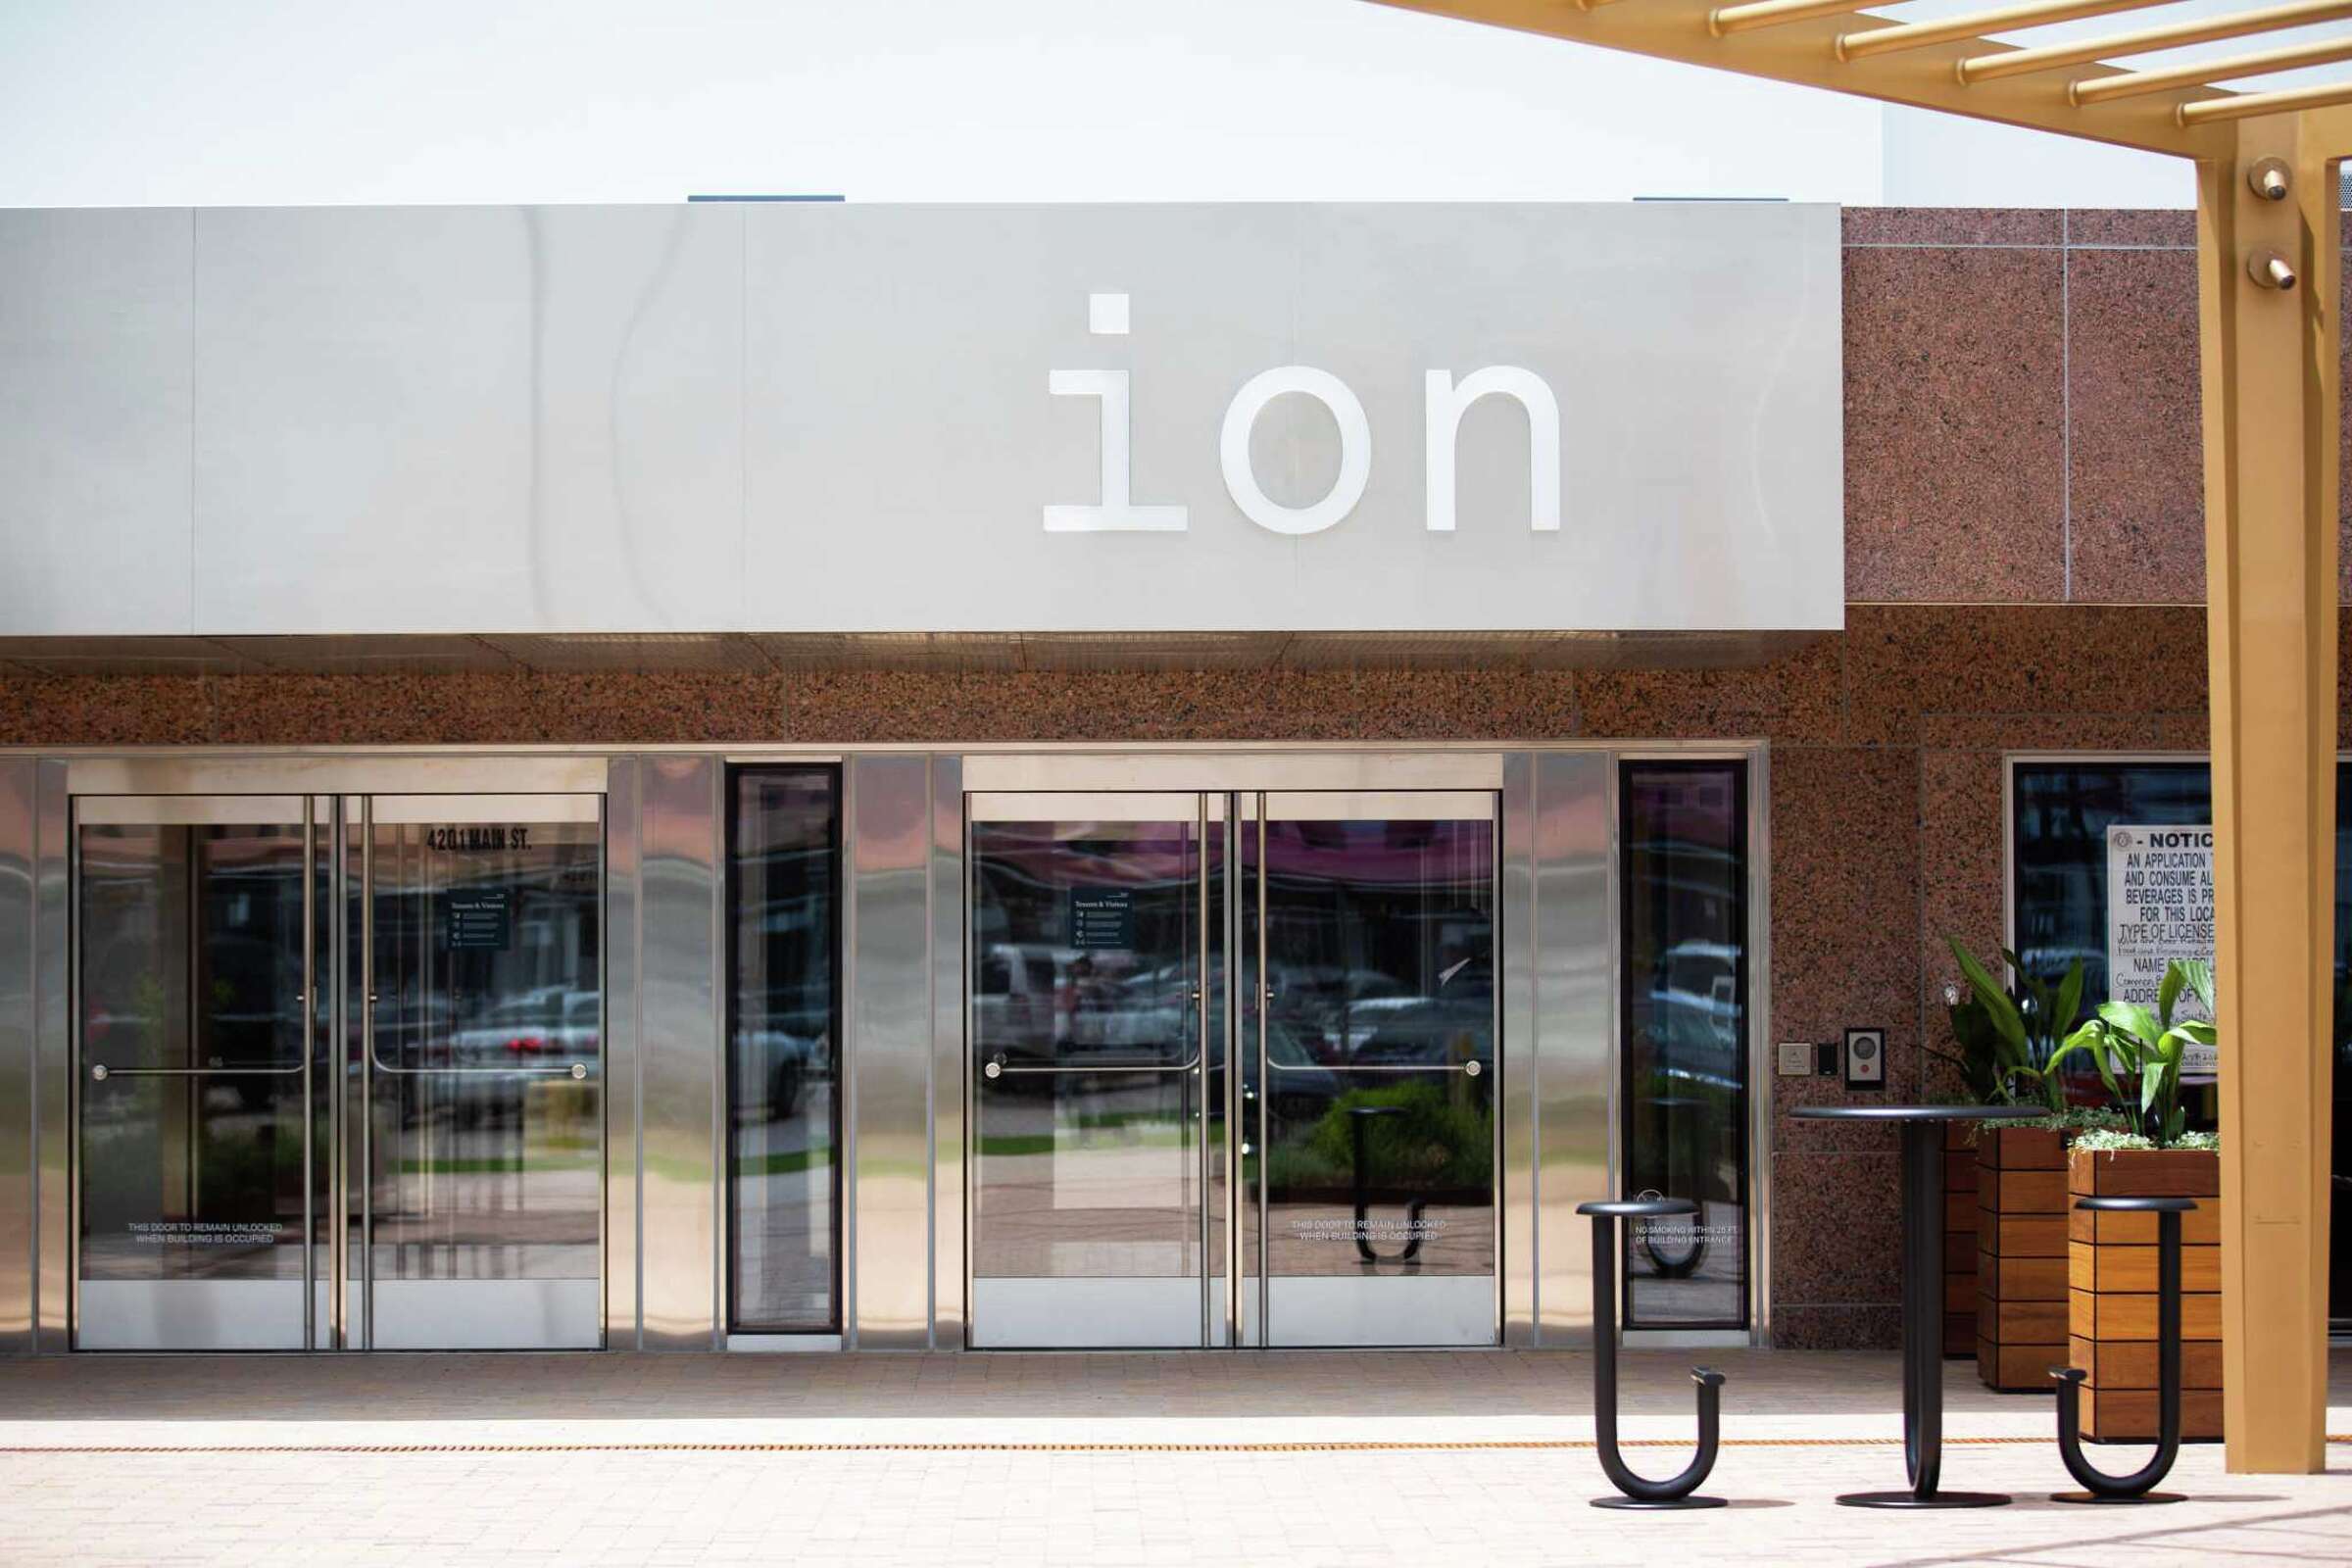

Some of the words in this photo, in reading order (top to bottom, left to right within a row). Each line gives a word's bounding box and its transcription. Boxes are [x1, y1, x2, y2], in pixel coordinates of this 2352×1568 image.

[1043, 293, 1560, 534] ion
[426, 828, 466, 851] 4201
[468, 828, 506, 851] MAIN
[511, 828, 532, 851] ST.
[2127, 853, 2140, 868] AN
[2144, 853, 2206, 868] APPLICATION
[2125, 870, 2144, 887] AND
[2149, 870, 2196, 887] CONSUME
[2126, 889, 2183, 904] BEVERAGES
[2188, 889, 2197, 904] IS
[2139, 906, 2160, 921] FOR
[2164, 906, 2185, 921] THIS
[2120, 924, 2148, 939] TYPE
[2150, 924, 2166, 939] OF
[2132, 957, 2165, 972] NAME
[128, 1223, 150, 1232] THIS
[150, 1223, 178, 1232] DOOR
[179, 1223, 192, 1232] TO
[193, 1223, 230, 1232] REMAIN
[231, 1223, 283, 1232] UNLOCKED
[1293, 1220, 1312, 1230] THIS
[1314, 1220, 1342, 1230] DOOR
[1344, 1220, 1355, 1230] TO
[1357, 1220, 1395, 1230] REMAIN
[1396, 1220, 1446, 1230] UNLOCKED
[136, 1234, 166, 1243] WHEN
[167, 1234, 213, 1243] BUILDING
[215, 1234, 223, 1243] IS
[224, 1234, 274, 1243] OCCUPIED
[1299, 1231, 1330, 1241] WHEN
[1332, 1231, 1376, 1241] BUILDING
[1377, 1231, 1388, 1241] IS
[1389, 1231, 1438, 1241] OCCUPIED
[1635, 1236, 1647, 1245] OF
[1647, 1236, 1688, 1245] BUILDING
[1688, 1236, 1733, 1245] ENTRANCE
